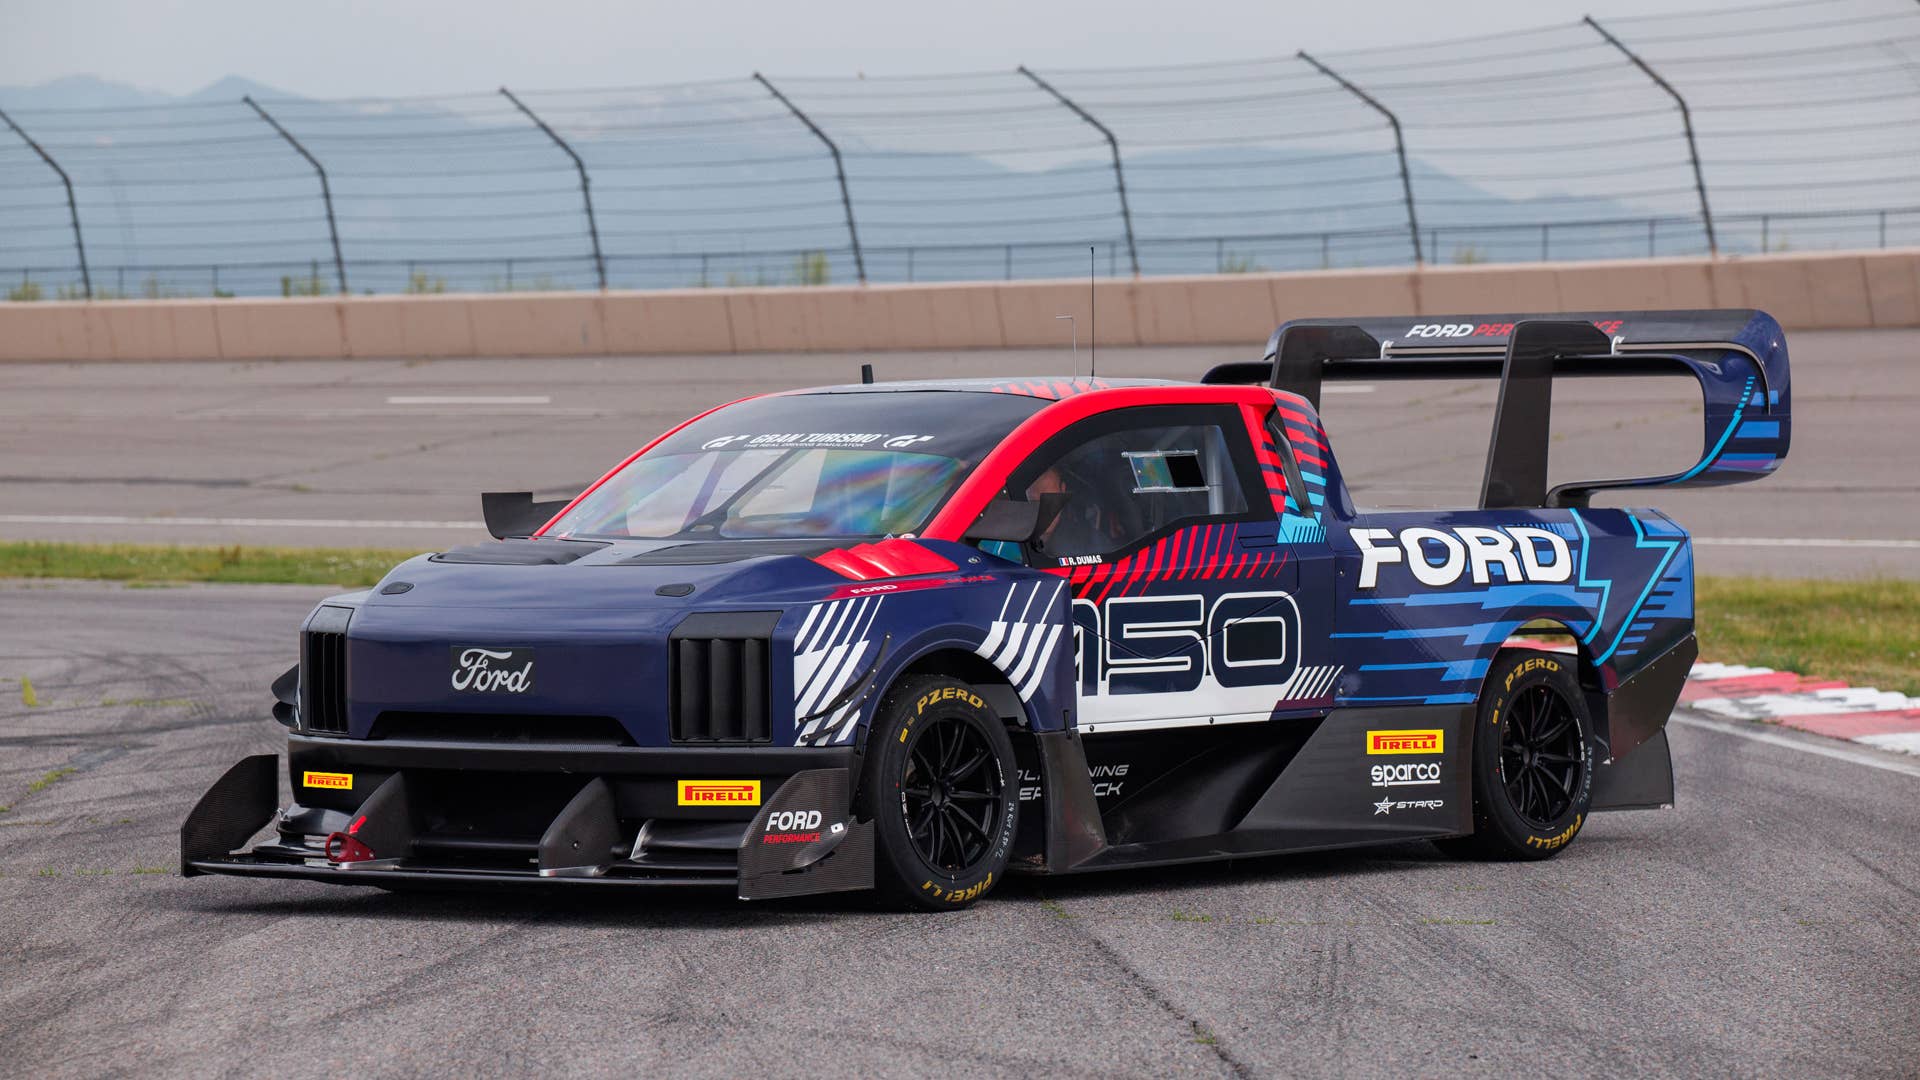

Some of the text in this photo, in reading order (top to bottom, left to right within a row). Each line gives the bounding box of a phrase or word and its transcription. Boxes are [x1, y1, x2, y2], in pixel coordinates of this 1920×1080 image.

[1405, 323, 1474, 338] FORD
[749, 433, 806, 444] GRAN
[1076, 554, 1103, 566] DUMAS
[1349, 527, 1573, 589] FORD
[850, 584, 898, 594] FORD
[451, 648, 533, 693] Ford
[1373, 734, 1437, 750] PIRELLI
[307, 774, 349, 787] PIRELLI
[1371, 762, 1441, 788] sparco
[684, 785, 754, 801] PIRELLI
[1396, 799, 1444, 810] STARD
[765, 810, 822, 831] FORD
[763, 832, 820, 844] PERFORMANCE
